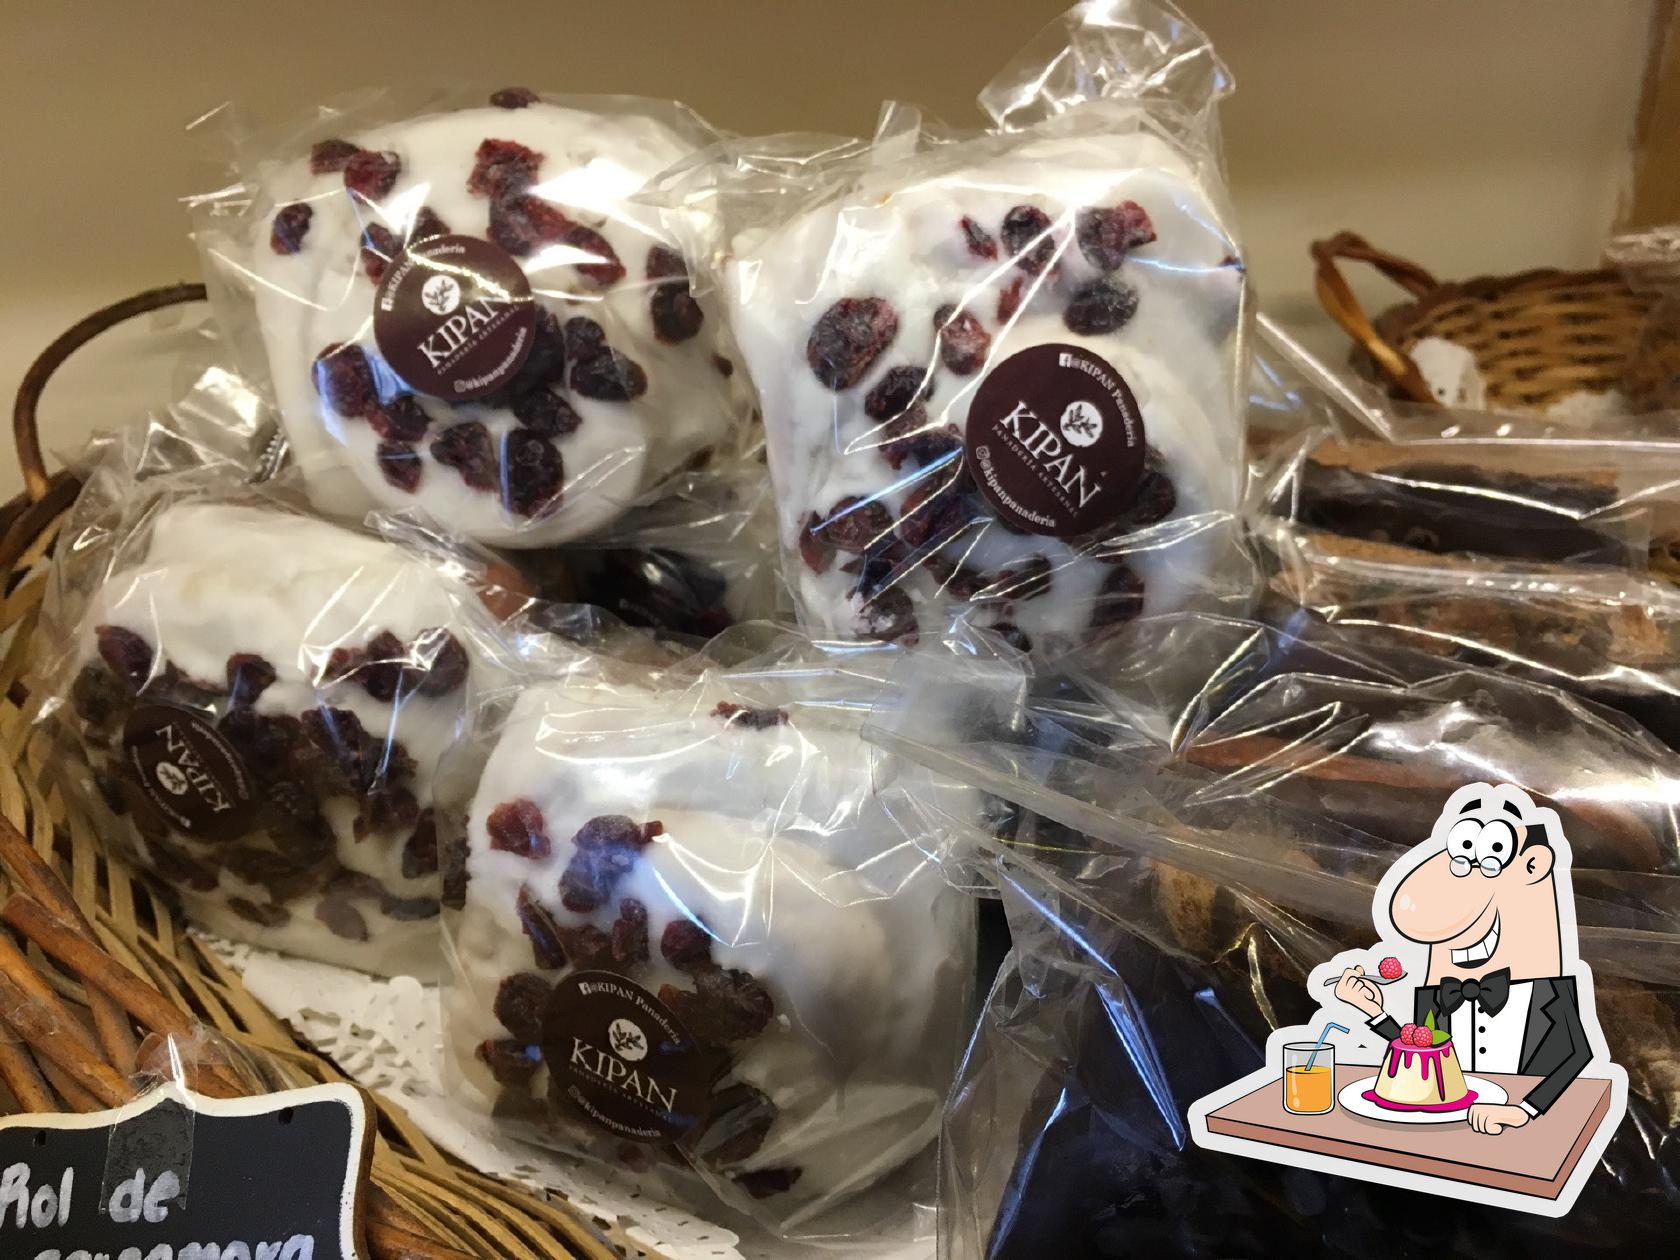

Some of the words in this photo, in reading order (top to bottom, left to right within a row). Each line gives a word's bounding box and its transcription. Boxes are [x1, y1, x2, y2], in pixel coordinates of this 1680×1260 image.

[999, 400, 1102, 508] KIPAN
[155, 724, 231, 813] KIPAN
[569, 1036, 678, 1113] KIPAN
[0, 1162, 74, 1229] Rol
[108, 1167, 180, 1223] de
